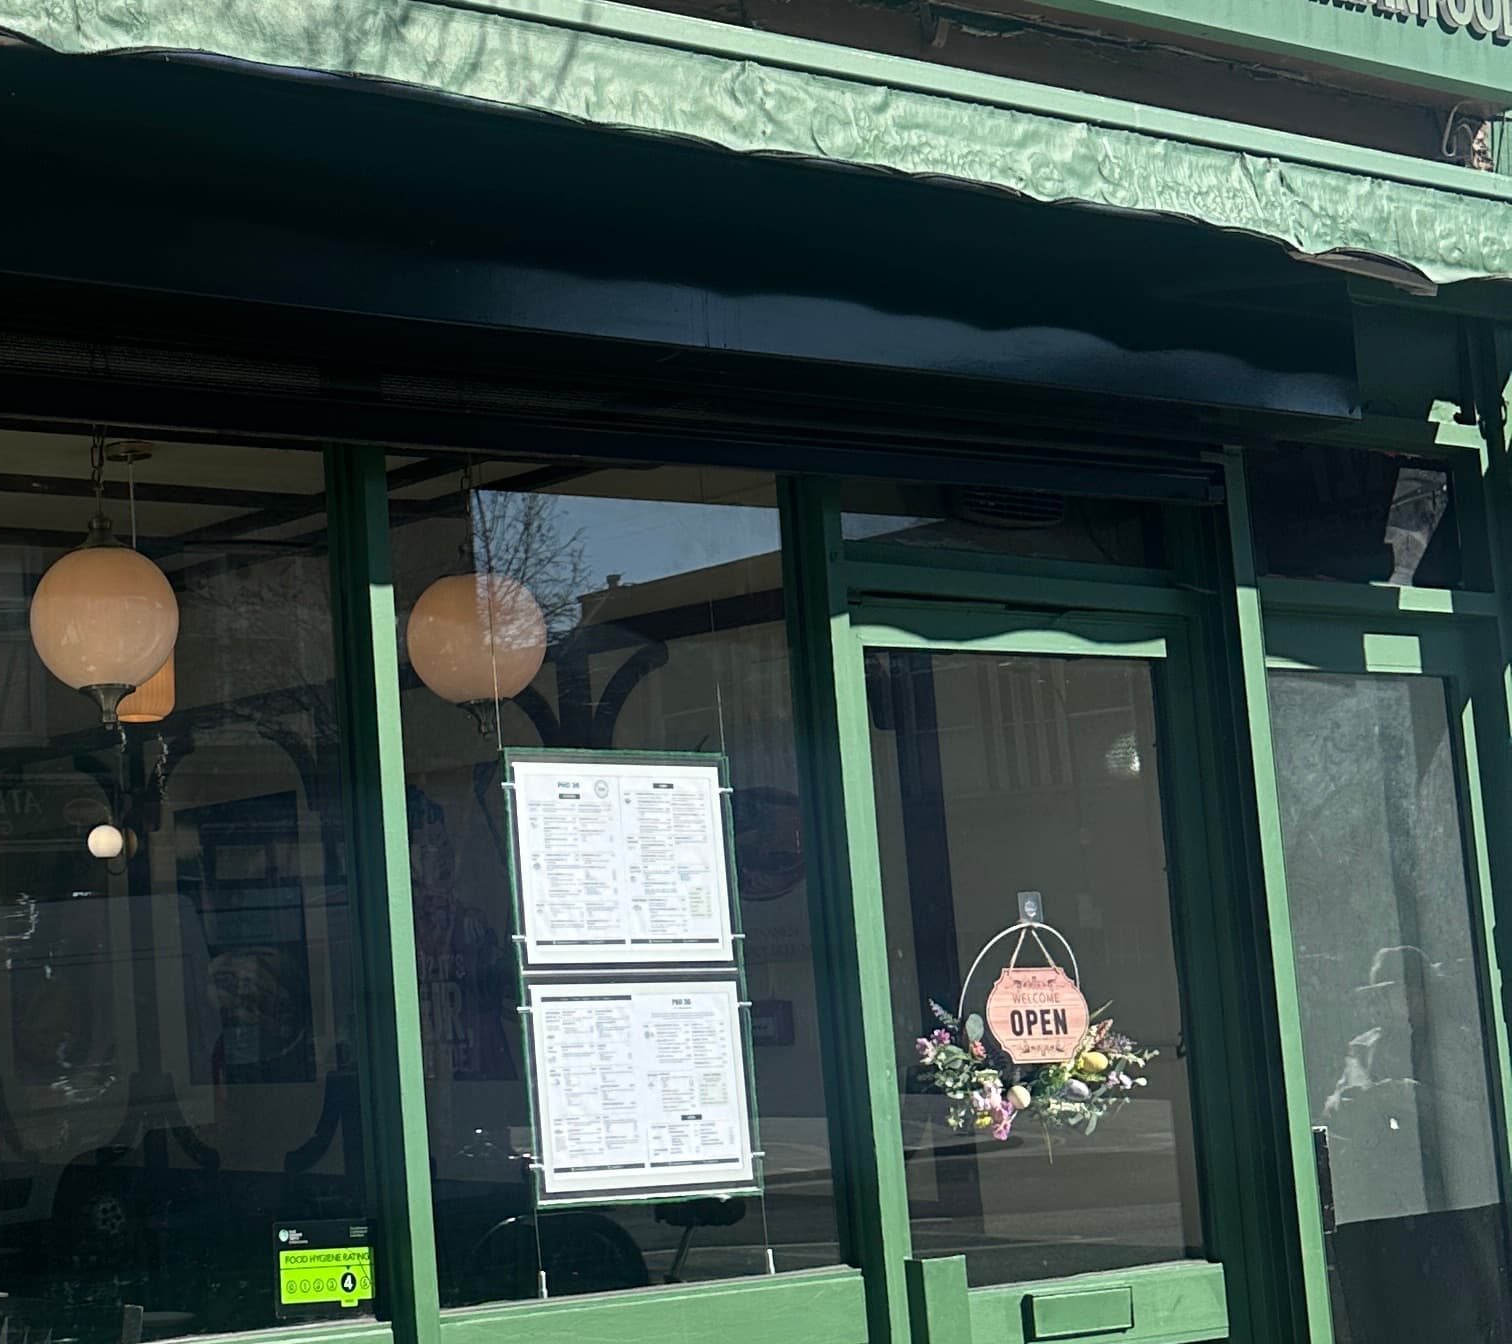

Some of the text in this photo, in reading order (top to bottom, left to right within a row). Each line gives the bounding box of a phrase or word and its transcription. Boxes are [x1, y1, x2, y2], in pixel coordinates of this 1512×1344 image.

[1012, 991, 1060, 1004] WELCOME
[1010, 1008, 1068, 1036] OPEN
[284, 1255, 308, 1264] FOOD
[309, 1253, 341, 1263] HYGIENE
